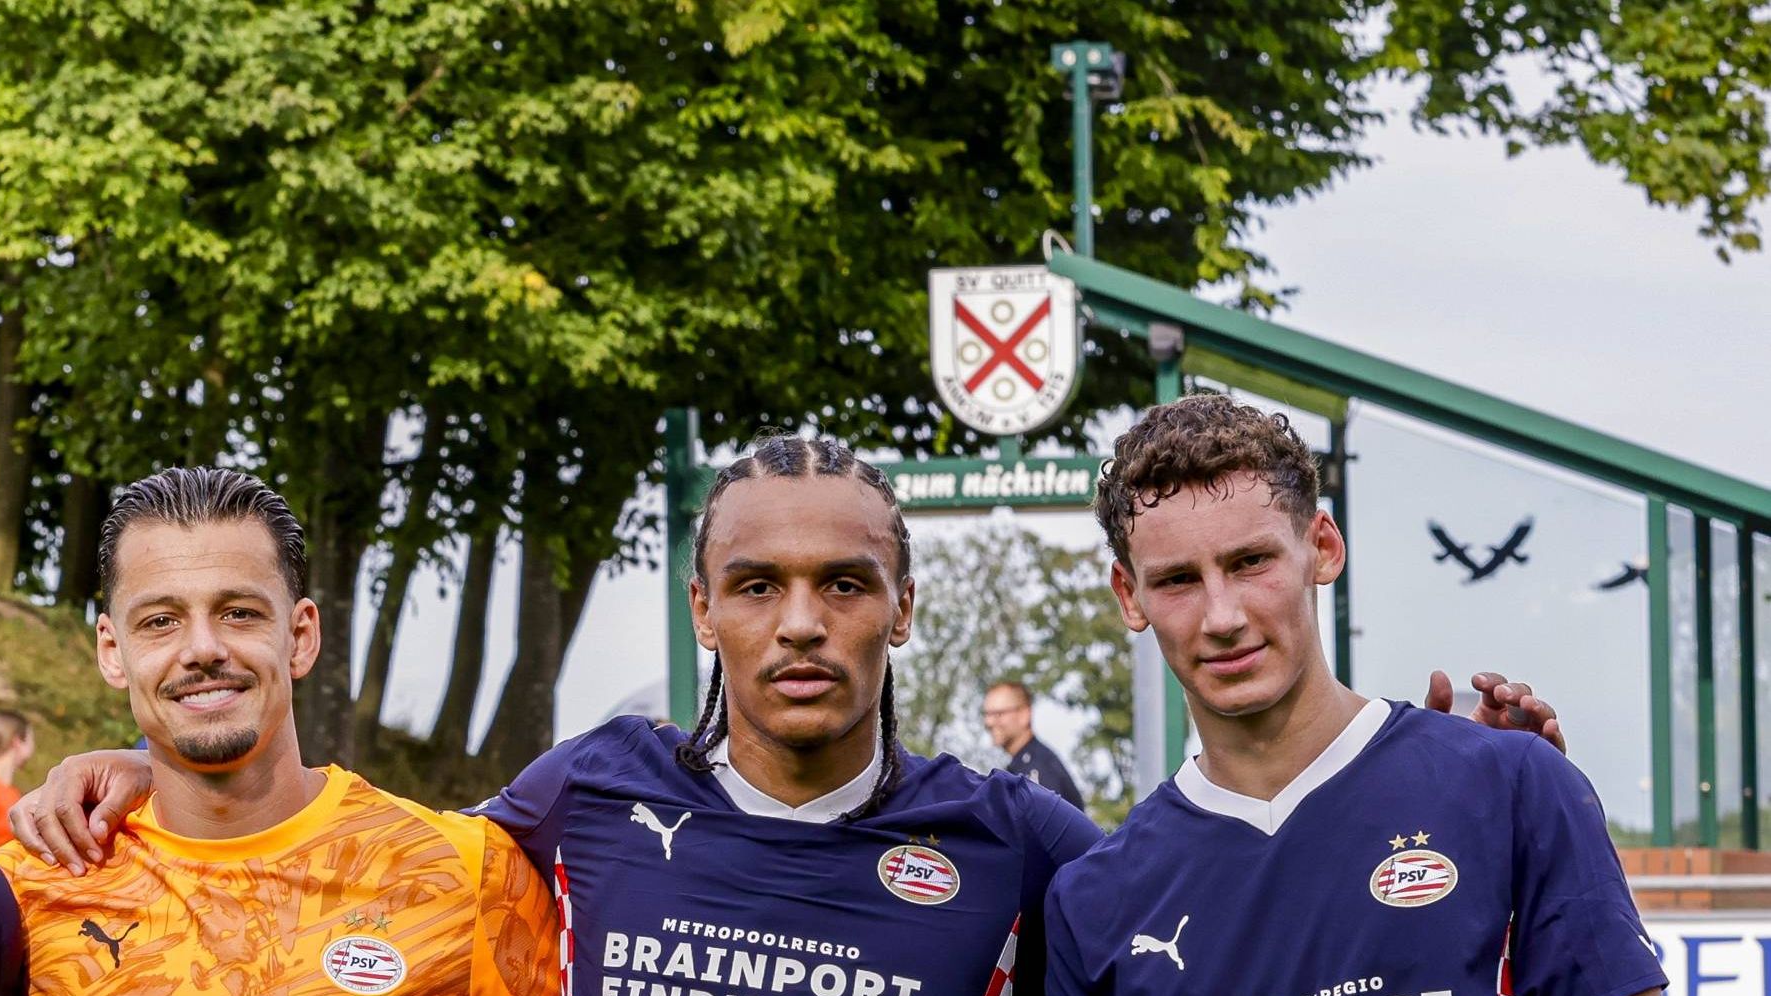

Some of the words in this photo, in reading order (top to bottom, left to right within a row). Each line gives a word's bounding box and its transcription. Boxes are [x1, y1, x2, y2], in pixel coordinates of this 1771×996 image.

[894, 472, 957, 502] zum
[961, 460, 1090, 498] nächsten
[905, 864, 935, 880] PSV
[1397, 869, 1428, 883] PSV
[662, 918, 861, 960] METROPOOLREGIO
[350, 956, 378, 969] PSV
